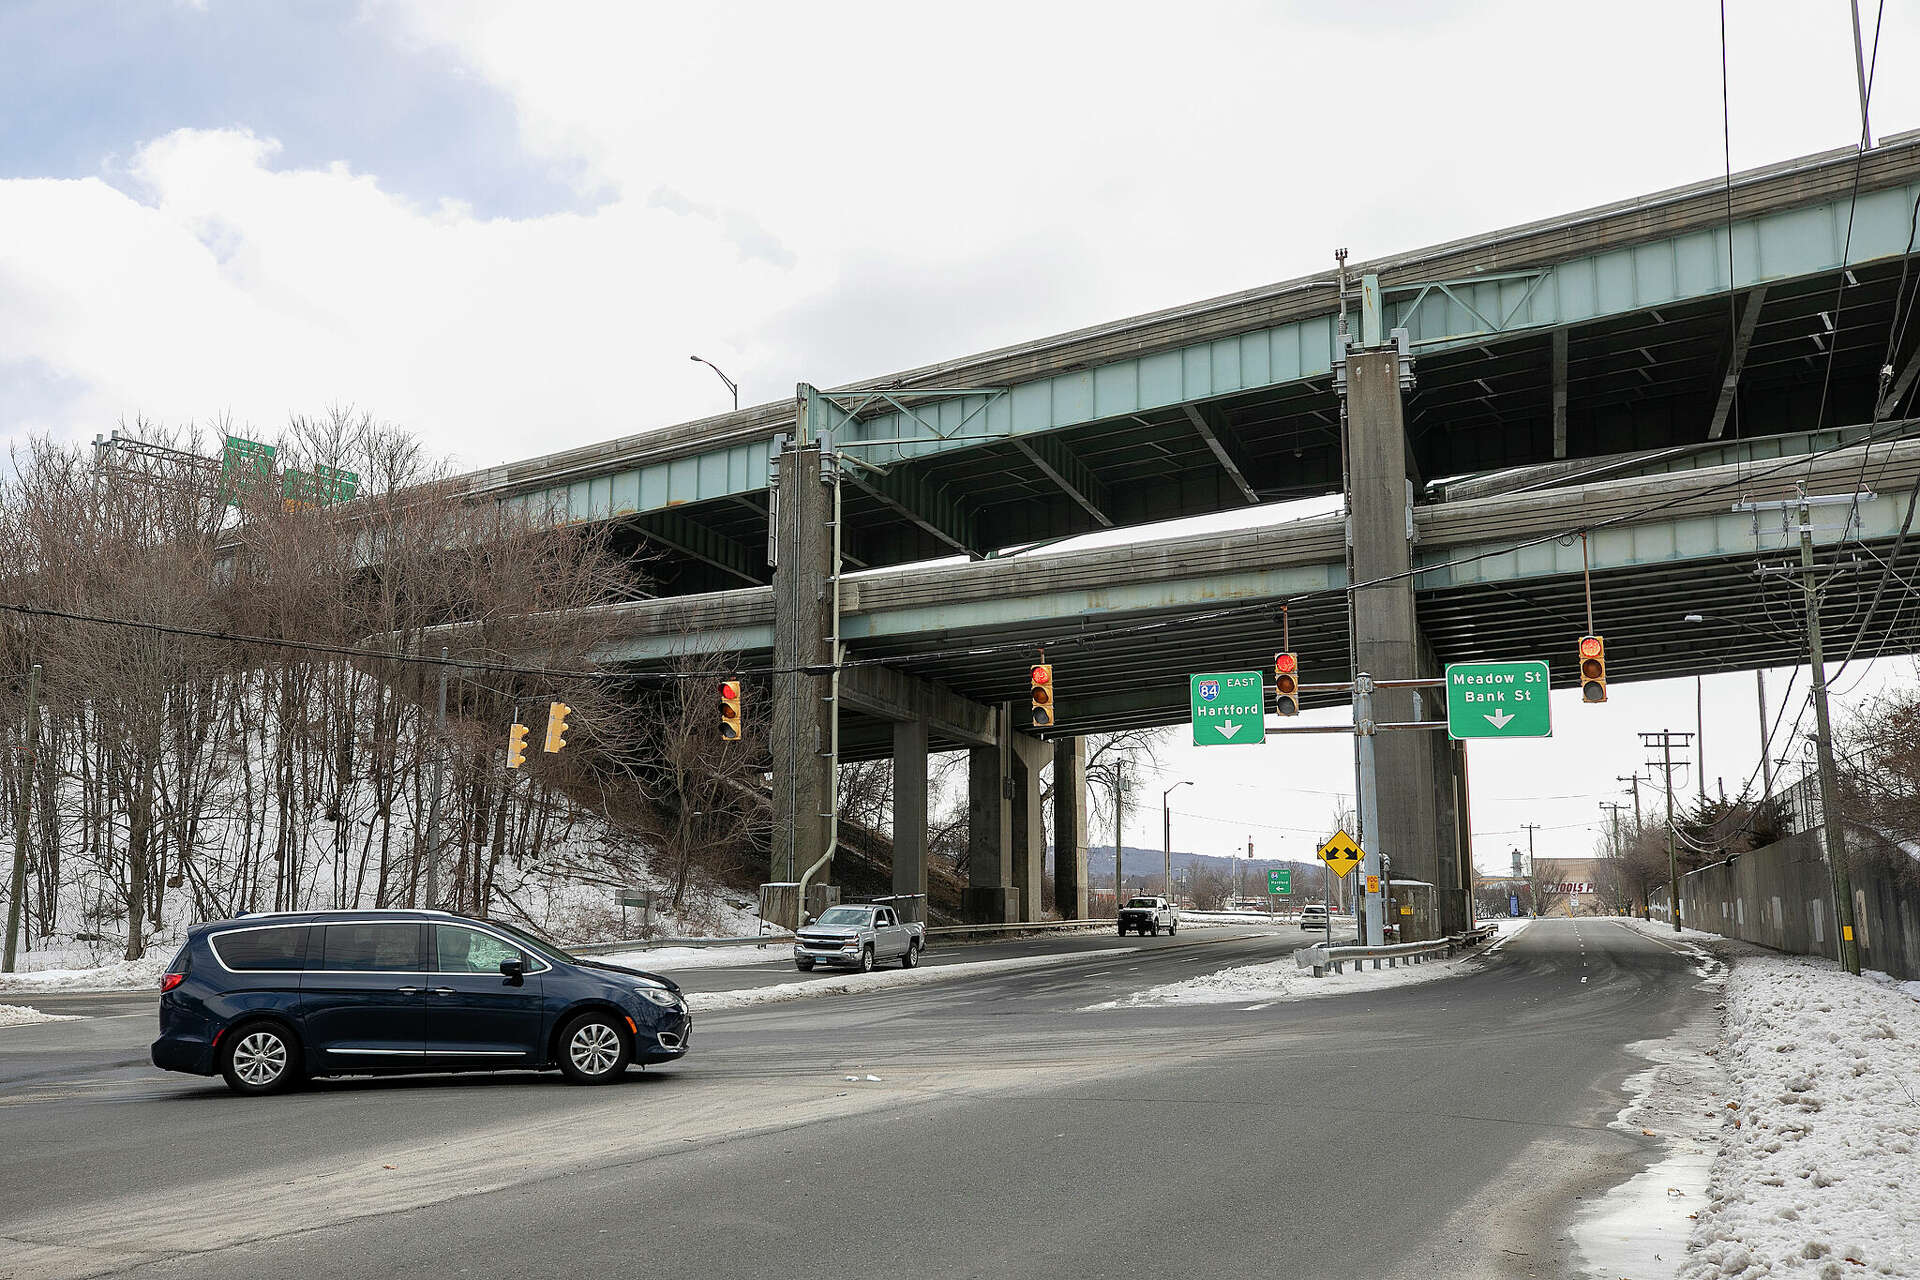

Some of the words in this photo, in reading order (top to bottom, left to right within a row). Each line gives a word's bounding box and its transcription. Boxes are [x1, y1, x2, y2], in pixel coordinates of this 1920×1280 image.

[1453, 673, 1515, 685] Meadow
[1524, 671, 1542, 683] St
[1201, 685, 1217, 697] 84
[1227, 678, 1254, 687] EAST
[1465, 691, 1505, 702] Bank
[1514, 690, 1531, 701] St
[1197, 704, 1258, 717] Hartford
